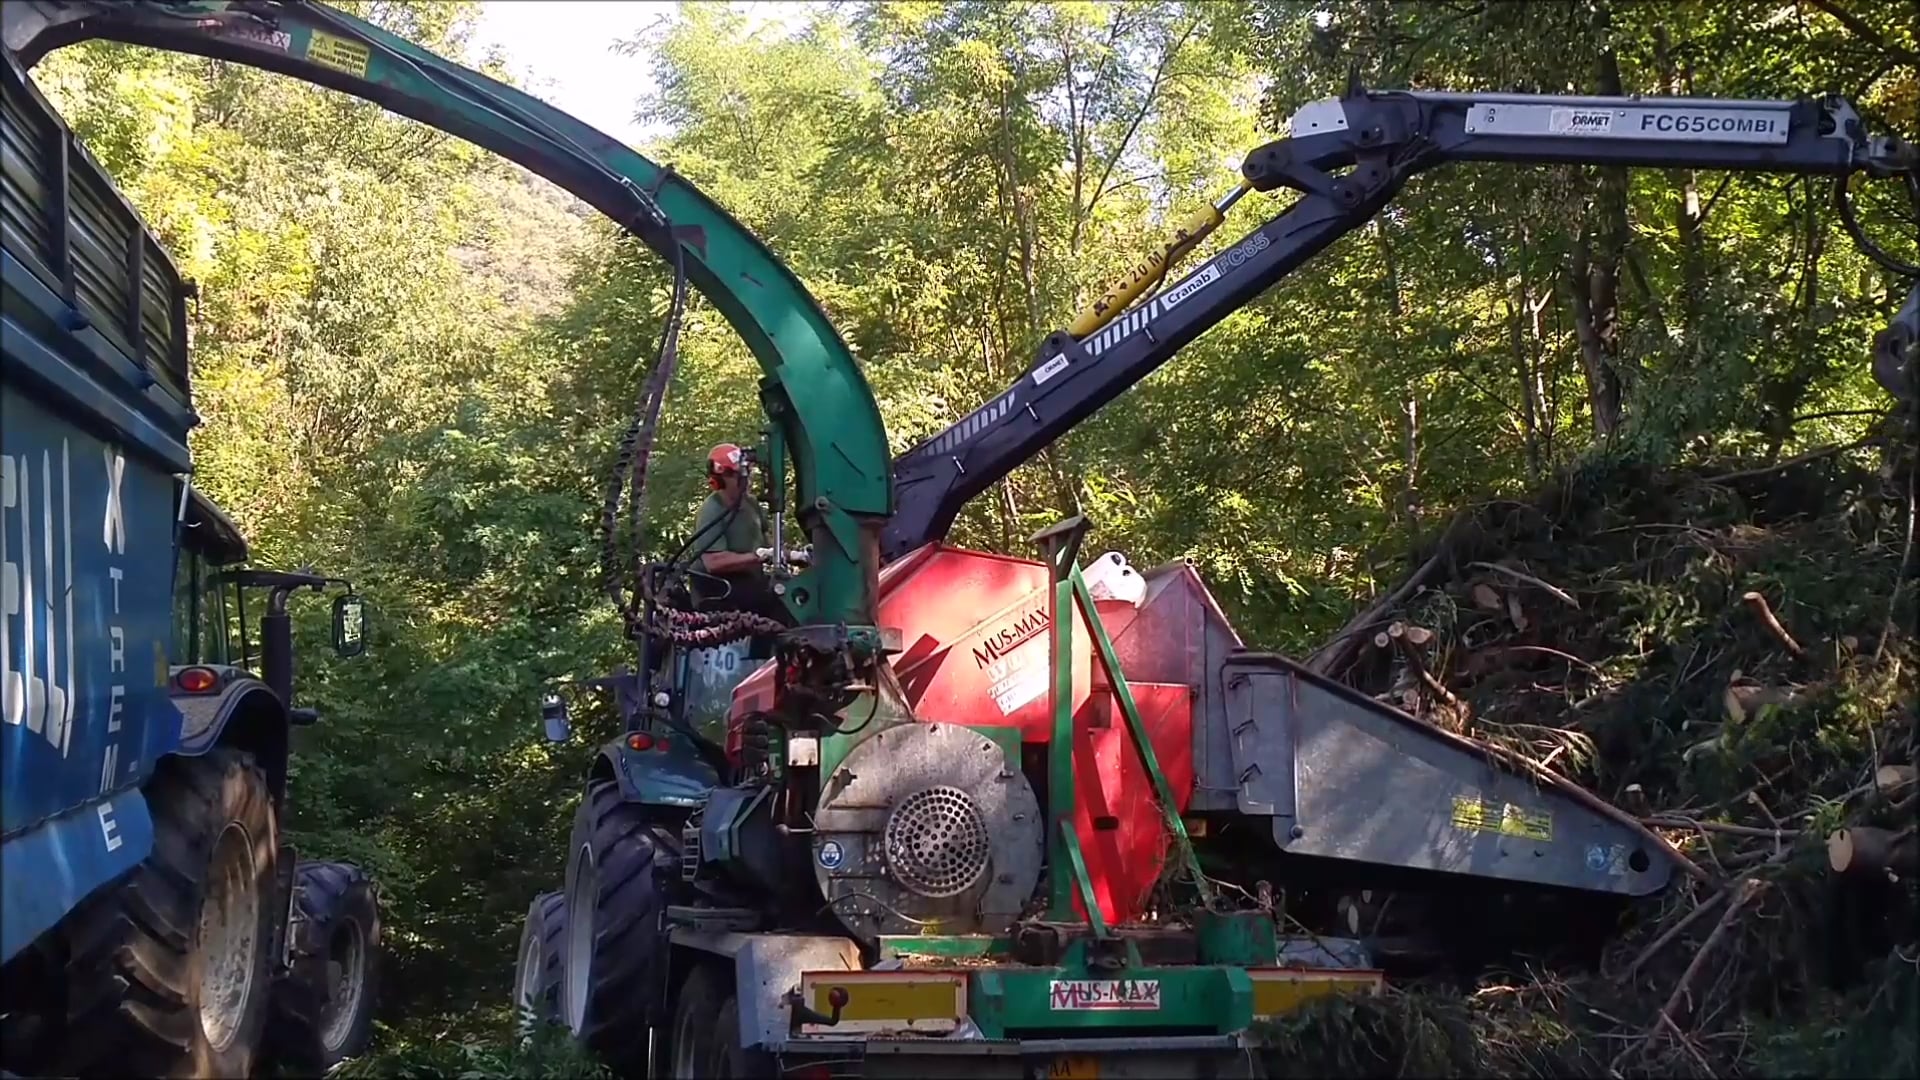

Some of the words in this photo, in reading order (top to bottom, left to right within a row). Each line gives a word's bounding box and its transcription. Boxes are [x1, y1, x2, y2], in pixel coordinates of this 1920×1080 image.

[1572, 115, 1610, 126] ORMET
[1217, 231, 1271, 276] FC65
[1129, 264, 1148, 283] 20
[971, 606, 1050, 669] MUS-MAX
[1051, 981, 1159, 1008] MUS-MAX
